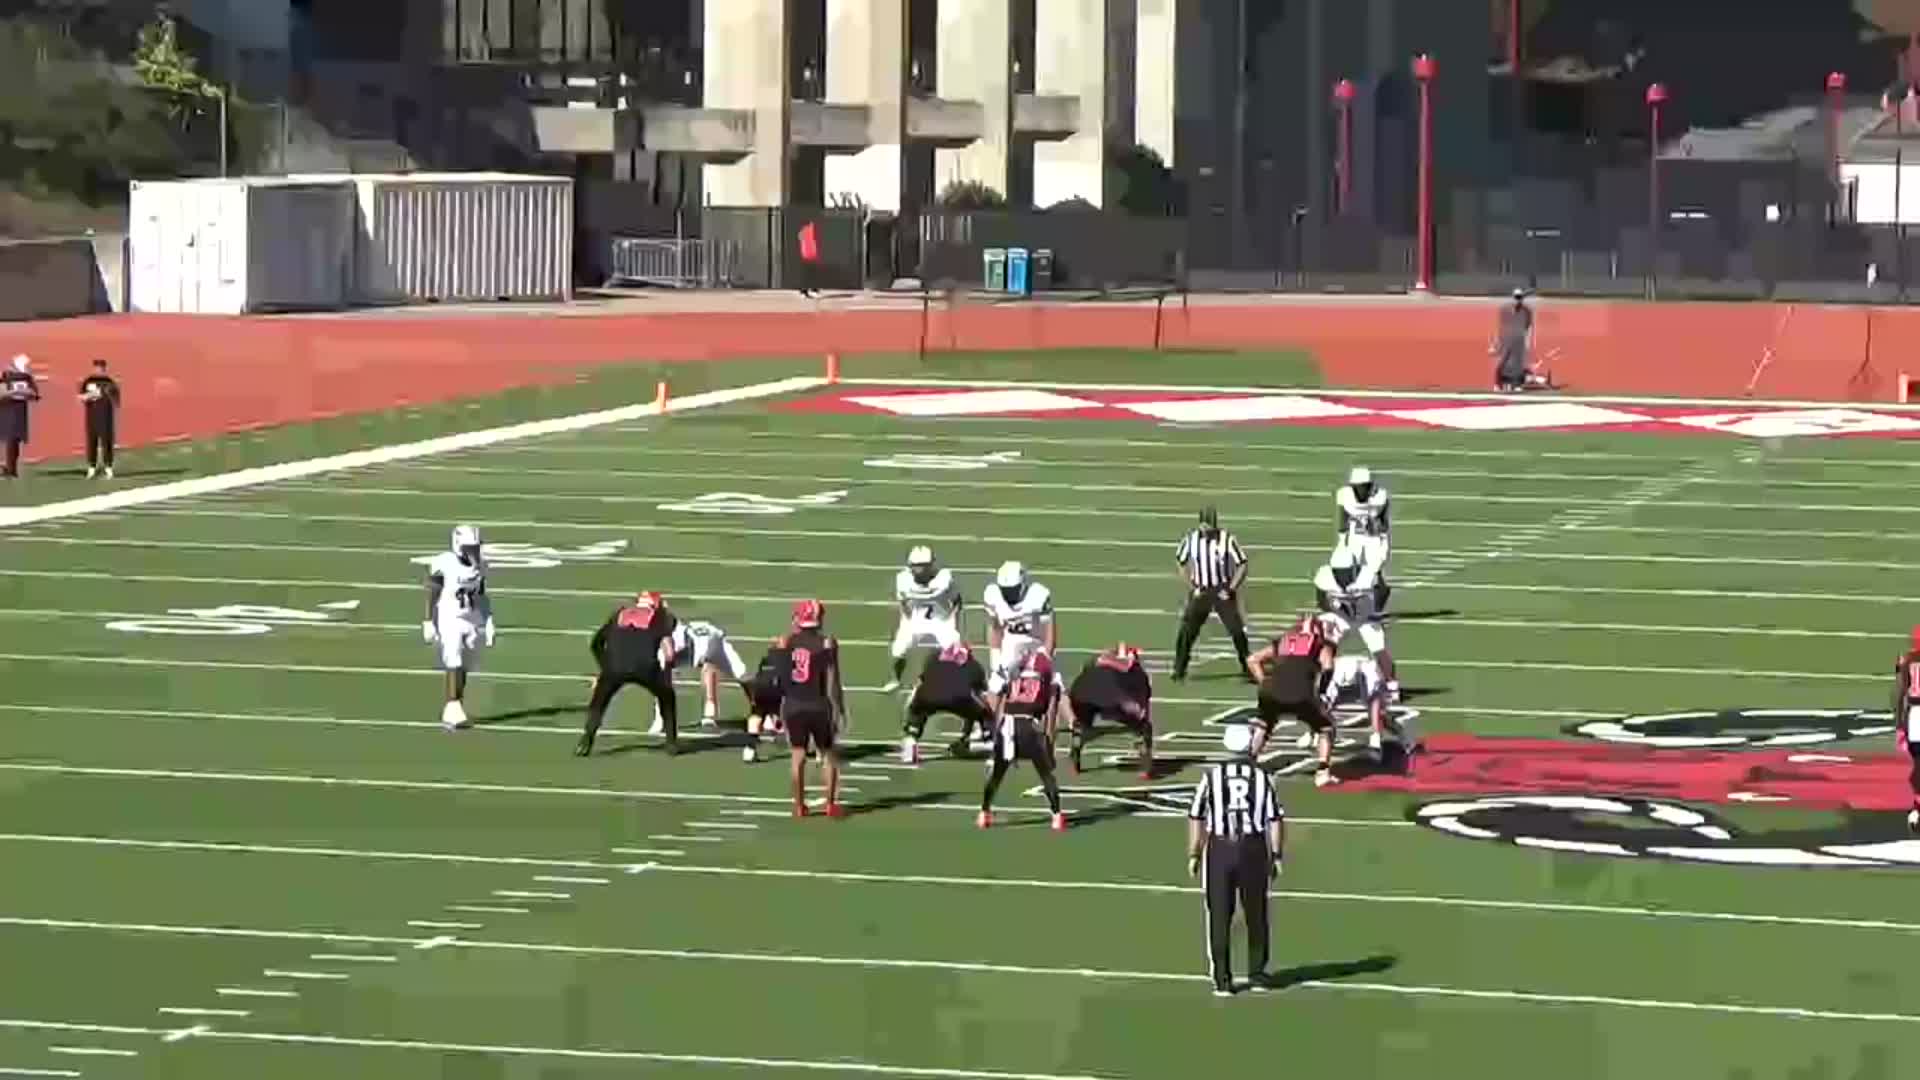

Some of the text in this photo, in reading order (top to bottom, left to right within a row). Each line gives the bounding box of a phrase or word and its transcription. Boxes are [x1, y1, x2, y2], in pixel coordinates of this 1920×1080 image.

[104, 604, 329, 636] 40
[791, 648, 810, 682] 3
[1227, 777, 1250, 810] R
